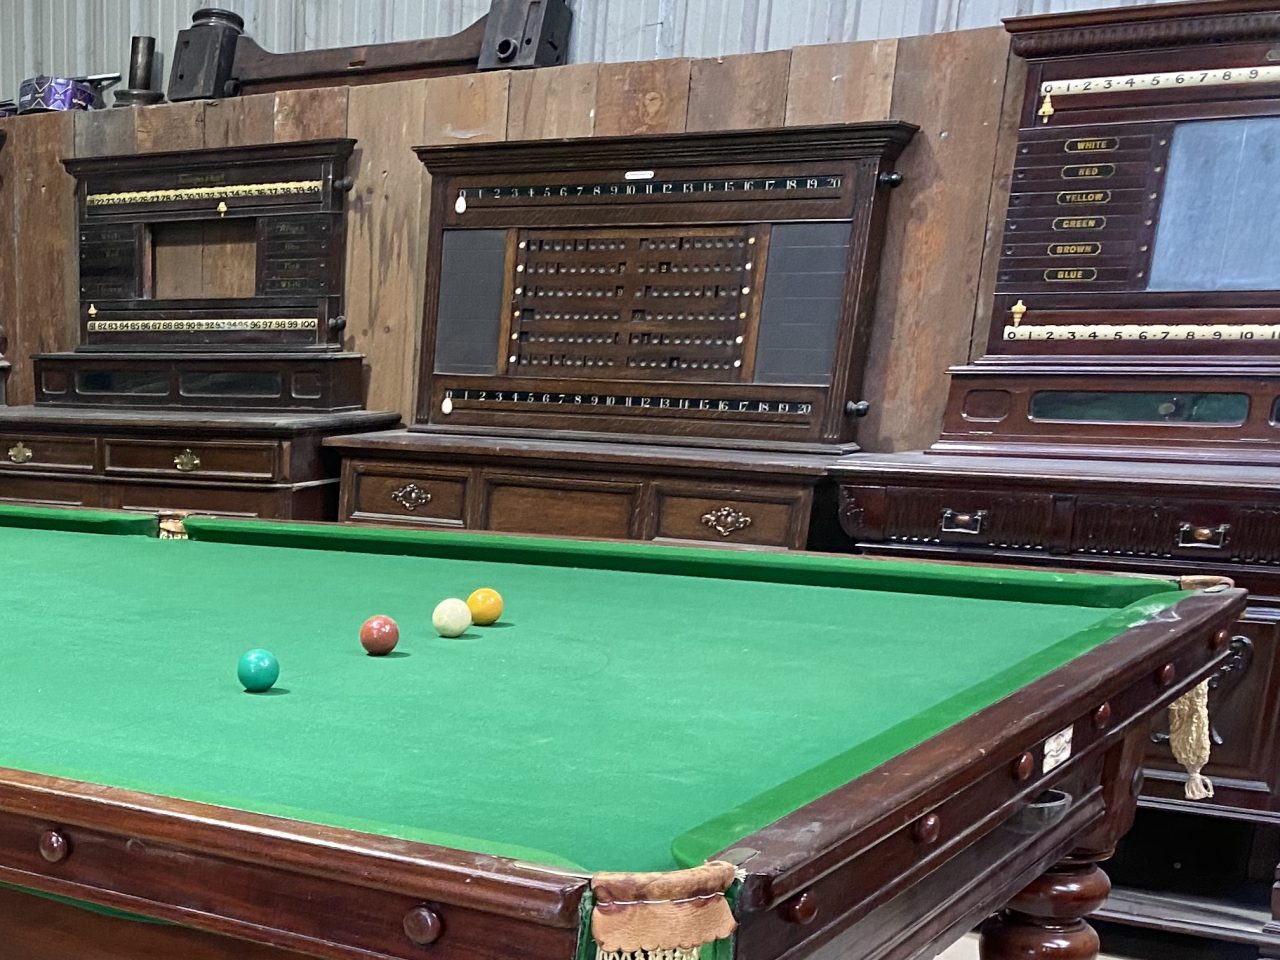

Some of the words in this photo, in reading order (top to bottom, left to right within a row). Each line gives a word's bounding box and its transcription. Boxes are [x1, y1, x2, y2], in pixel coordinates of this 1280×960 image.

[1045, 84, 1052, 93] 0
[1066, 83, 1070, 92] 1
[1083, 81, 1092, 90] 2
[1103, 79, 1112, 89] 3
[1125, 78, 1135, 87] 4
[1150, 76, 1160, 85] 5
[1176, 74, 1185, 84] 6
[1199, 73, 1208, 82] 7
[1222, 71, 1231, 81] 8
[1249, 69, 1258, 79] 9
[1078, 141, 1106, 150] WHITE
[478, 189, 482, 198] 1
[494, 189, 501, 198] 2
[511, 189, 518, 198] 3
[543, 188, 550, 197] 5
[560, 188, 567, 197] 6
[577, 187, 583, 196] 7
[593, 186, 601, 195] 8
[611, 186, 618, 195] 9
[626, 185, 635, 194] 10
[645, 185, 653, 194] 11
[663, 184, 672, 194] 12
[683, 183, 693, 193] 13
[724, 182, 734, 192] 15
[744, 181, 754, 191] 16
[765, 181, 775, 190] 17
[786, 180, 796, 189] 18
[807, 179, 817, 189] 19
[827, 178, 841, 188] 20
[1066, 193, 1103, 201] YELLOW
[1056, 246, 1092, 254] BROWN
[1046, 332, 1054, 340] 2
[1067, 332, 1076, 340] 3
[1114, 332, 1122, 340] 5
[1139, 331, 1148, 340] 6
[1161, 331, 1170, 340] 7
[1186, 331, 1195, 340] 8
[1212, 331, 1222, 340] 9
[1240, 331, 1254, 339] 10
[464, 391, 468, 400] 1
[479, 392, 486, 401] 2
[495, 392, 502, 401] 3
[512, 393, 519, 402] 4
[527, 393, 534, 402] 5
[543, 394, 550, 403] 6
[558, 395, 565, 404] 7
[574, 395, 581, 405] 8
[591, 396, 598, 405] 9
[606, 396, 615, 405] 10
[625, 397, 632, 407] 11
[641, 398, 650, 408] 12
[660, 398, 670, 408] 13
[699, 400, 709, 410] 15
[719, 400, 728, 411] 16
[738, 401, 748, 411] 17
[759, 402, 768, 412] 18
[778, 403, 789, 413] 19
[798, 404, 811, 415] 20
